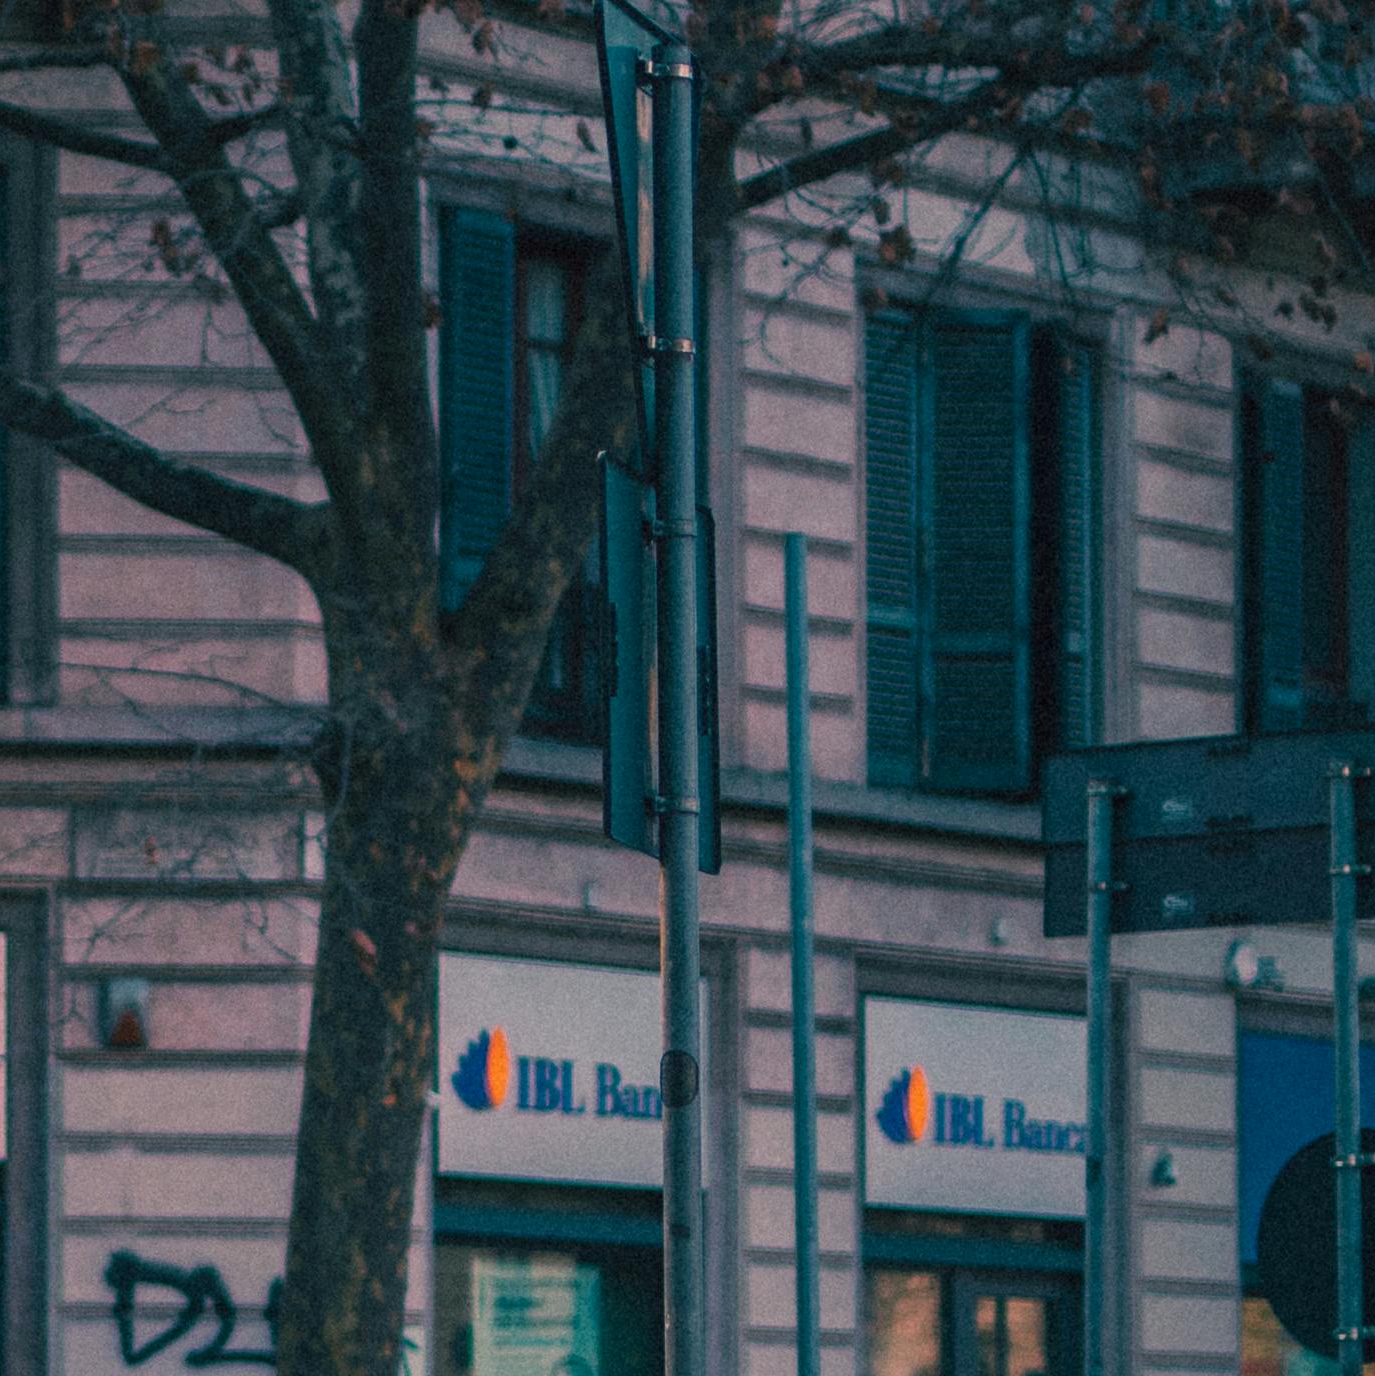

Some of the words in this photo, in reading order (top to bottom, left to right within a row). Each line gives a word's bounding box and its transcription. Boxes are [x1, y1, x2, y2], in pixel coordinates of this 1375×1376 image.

[515, 1054, 586, 1116] IBL
[595, 1062, 662, 1120] Ban
[934, 1091, 994, 1149] IBL
